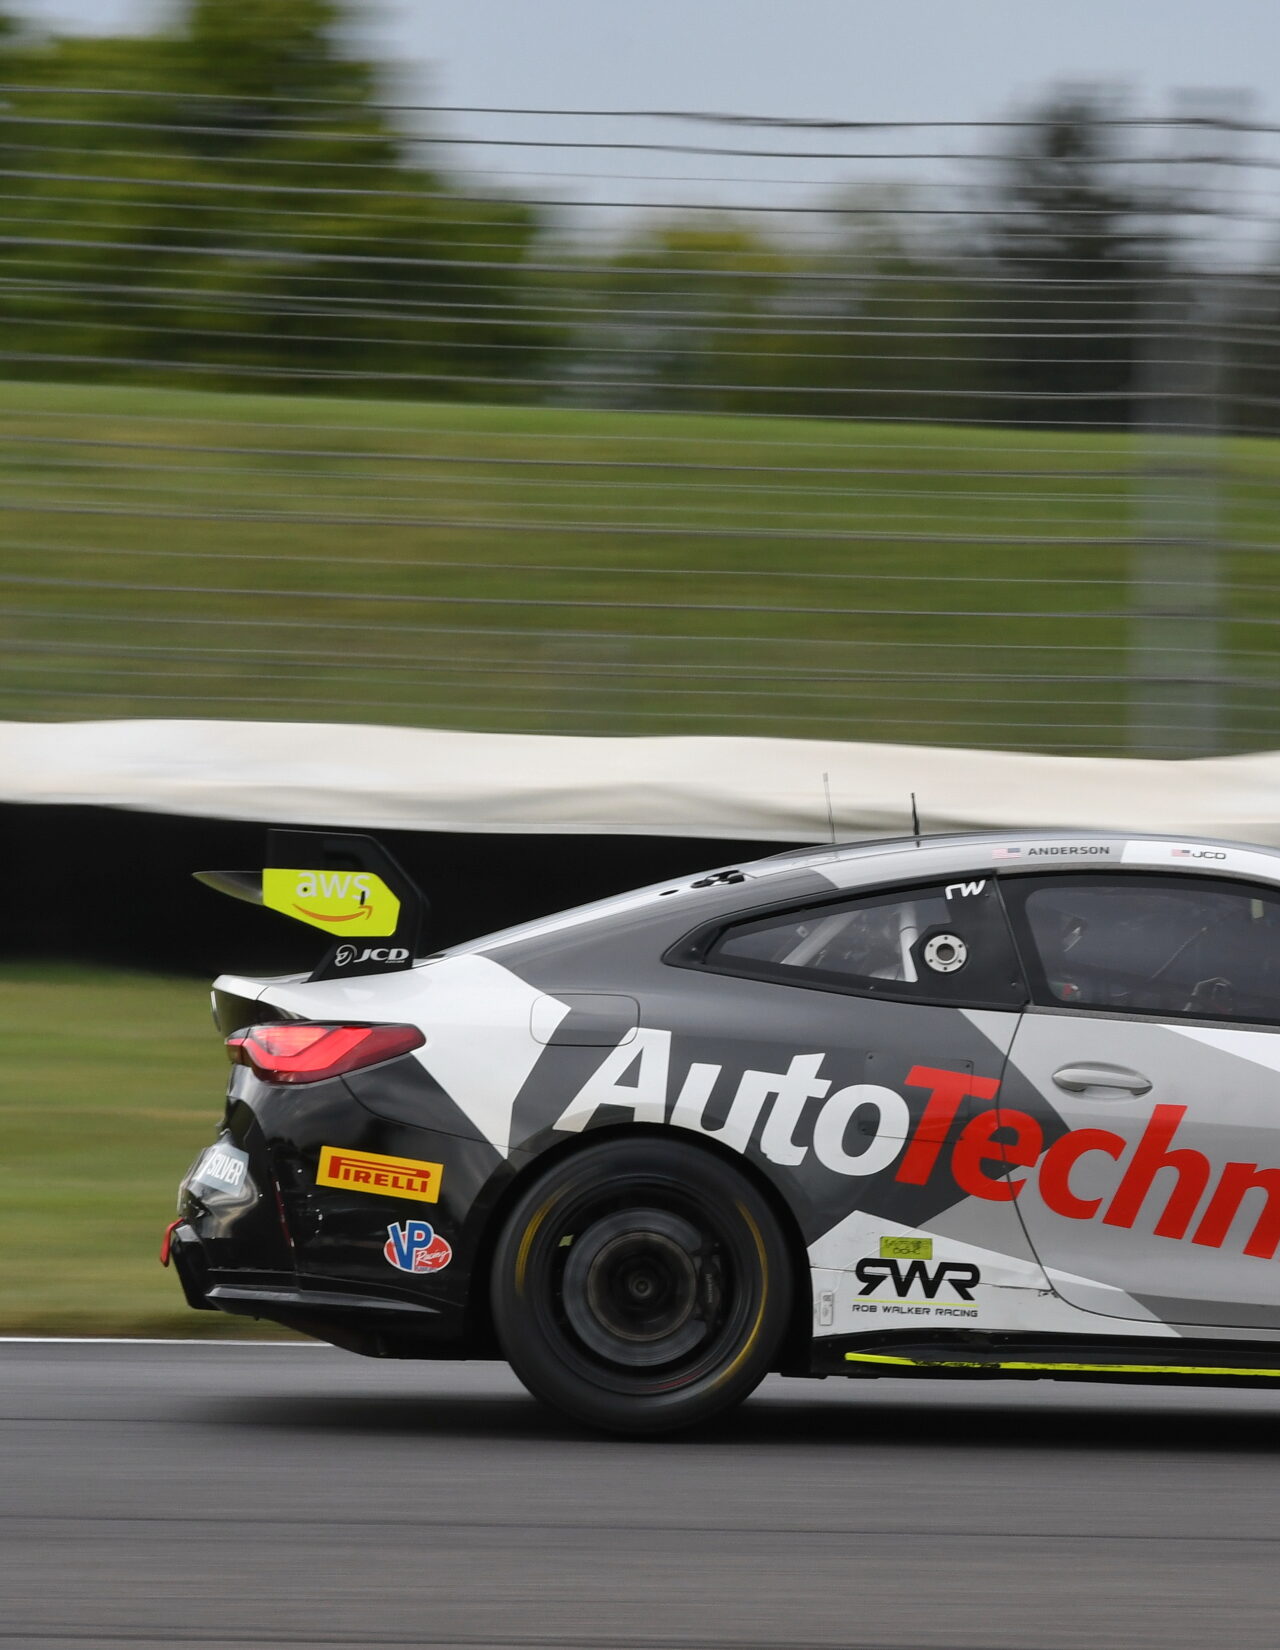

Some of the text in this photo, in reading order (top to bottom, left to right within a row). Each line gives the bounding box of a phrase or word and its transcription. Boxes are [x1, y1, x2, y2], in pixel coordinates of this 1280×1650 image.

[1027, 846, 1110, 856] ANDERSON
[1192, 851, 1226, 860] JCD
[296, 872, 371, 901] aws
[353, 948, 409, 962] JCD
[207, 1153, 244, 1186] SILVER
[328, 1155, 431, 1193] PIRELLI
[388, 1221, 433, 1271] VP
[852, 1304, 978, 1318] ROB WALKER RACING
